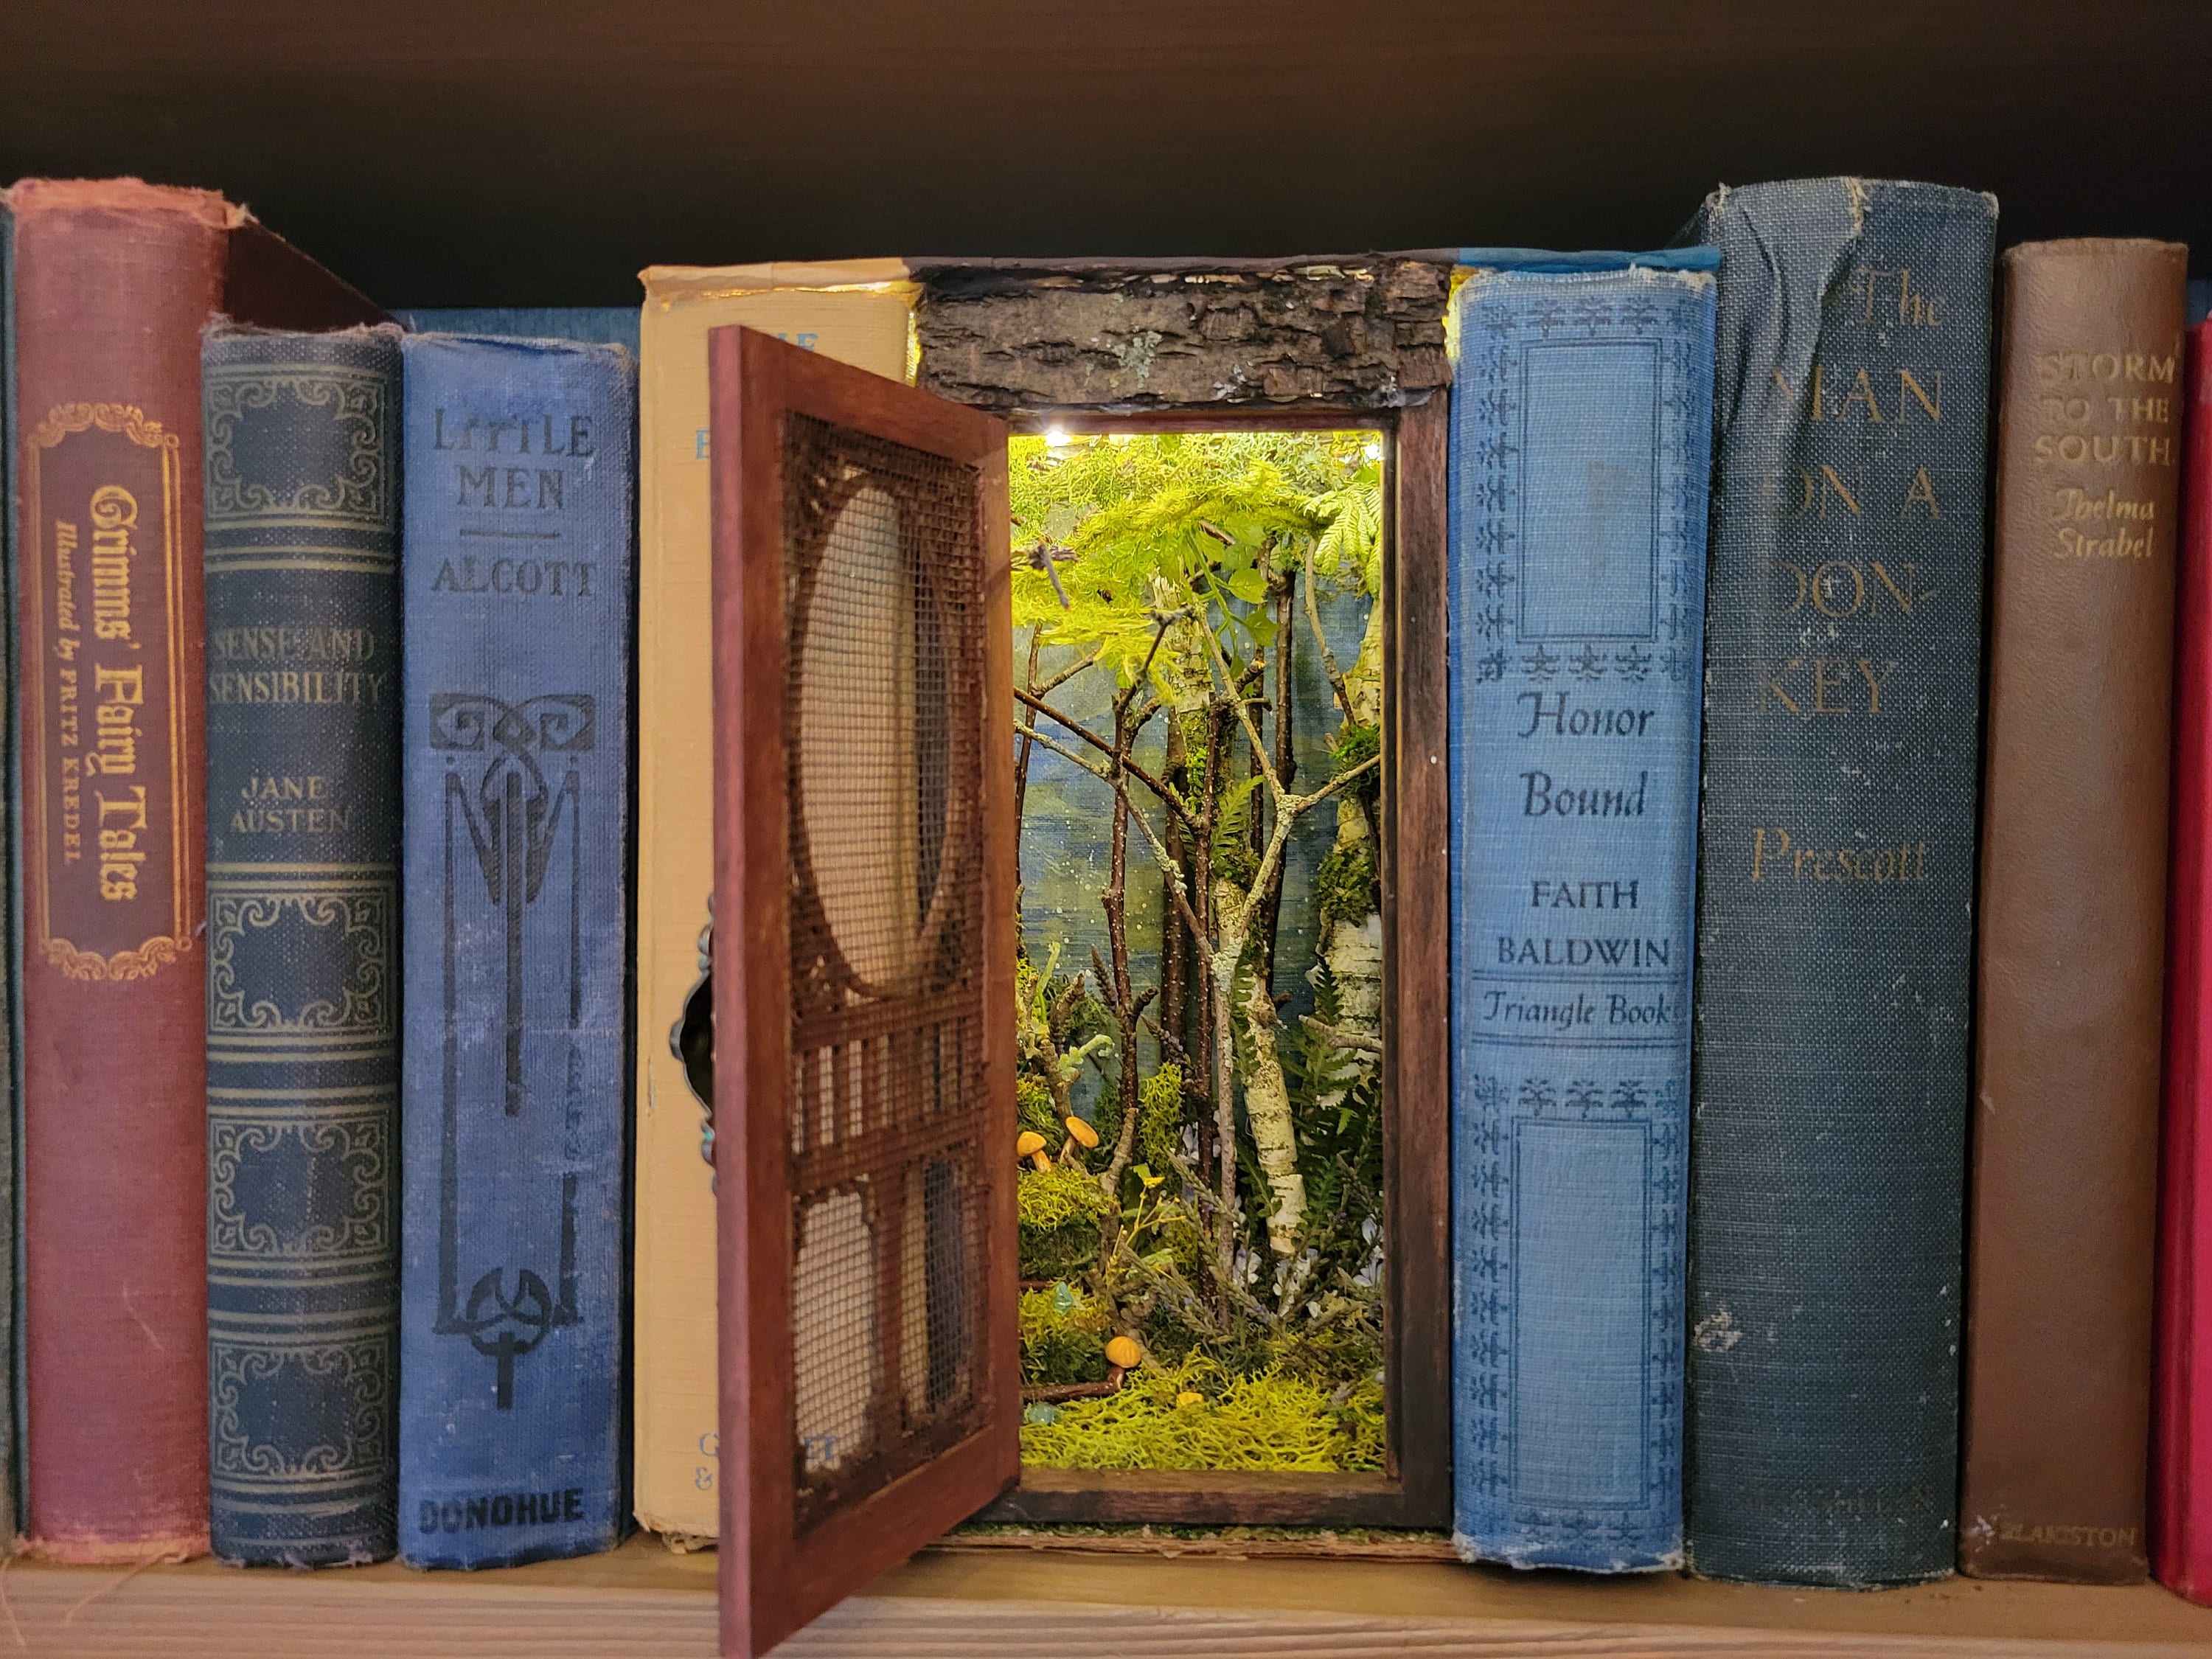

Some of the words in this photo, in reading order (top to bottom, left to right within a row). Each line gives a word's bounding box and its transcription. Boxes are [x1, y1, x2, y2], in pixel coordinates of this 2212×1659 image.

[1849, 268, 1945, 327] The
[2040, 351, 2175, 383] STORM
[2039, 395, 2090, 425] TO
[2110, 397, 2170, 423] THE
[433, 408, 596, 458] LITTLE
[2034, 434, 2171, 466] SOUTH
[456, 465, 566, 510] MEN
[1901, 467, 1941, 518] A
[2056, 487, 2154, 521] Thelma
[2056, 526, 2154, 559] Strabel
[55, 519, 80, 631] Illustrated
[90, 484, 142, 650] Grimms'
[431, 556, 597, 597] ALCOTT
[53, 638, 80, 661] by
[212, 627, 296, 661] SENSE
[306, 627, 375, 661] AND
[60, 668, 78, 747] FRITZ
[209, 670, 388, 704] SENSIBILITY
[1760, 659, 1897, 714] KEY
[86, 663, 145, 777] Fairy
[1517, 690, 1655, 738] Honor
[240, 776, 329, 801] JANE
[1518, 770, 1649, 818] Bound
[229, 808, 352, 834] AUSTEN
[94, 785, 147, 901] Tales
[1751, 827, 1927, 882] Prescott
[1531, 880, 1639, 909] FAITH
[1498, 936, 1669, 968] BALDWIN
[1484, 990, 1596, 1031] Triangle
[419, 1487, 585, 1534] DONOHUE
